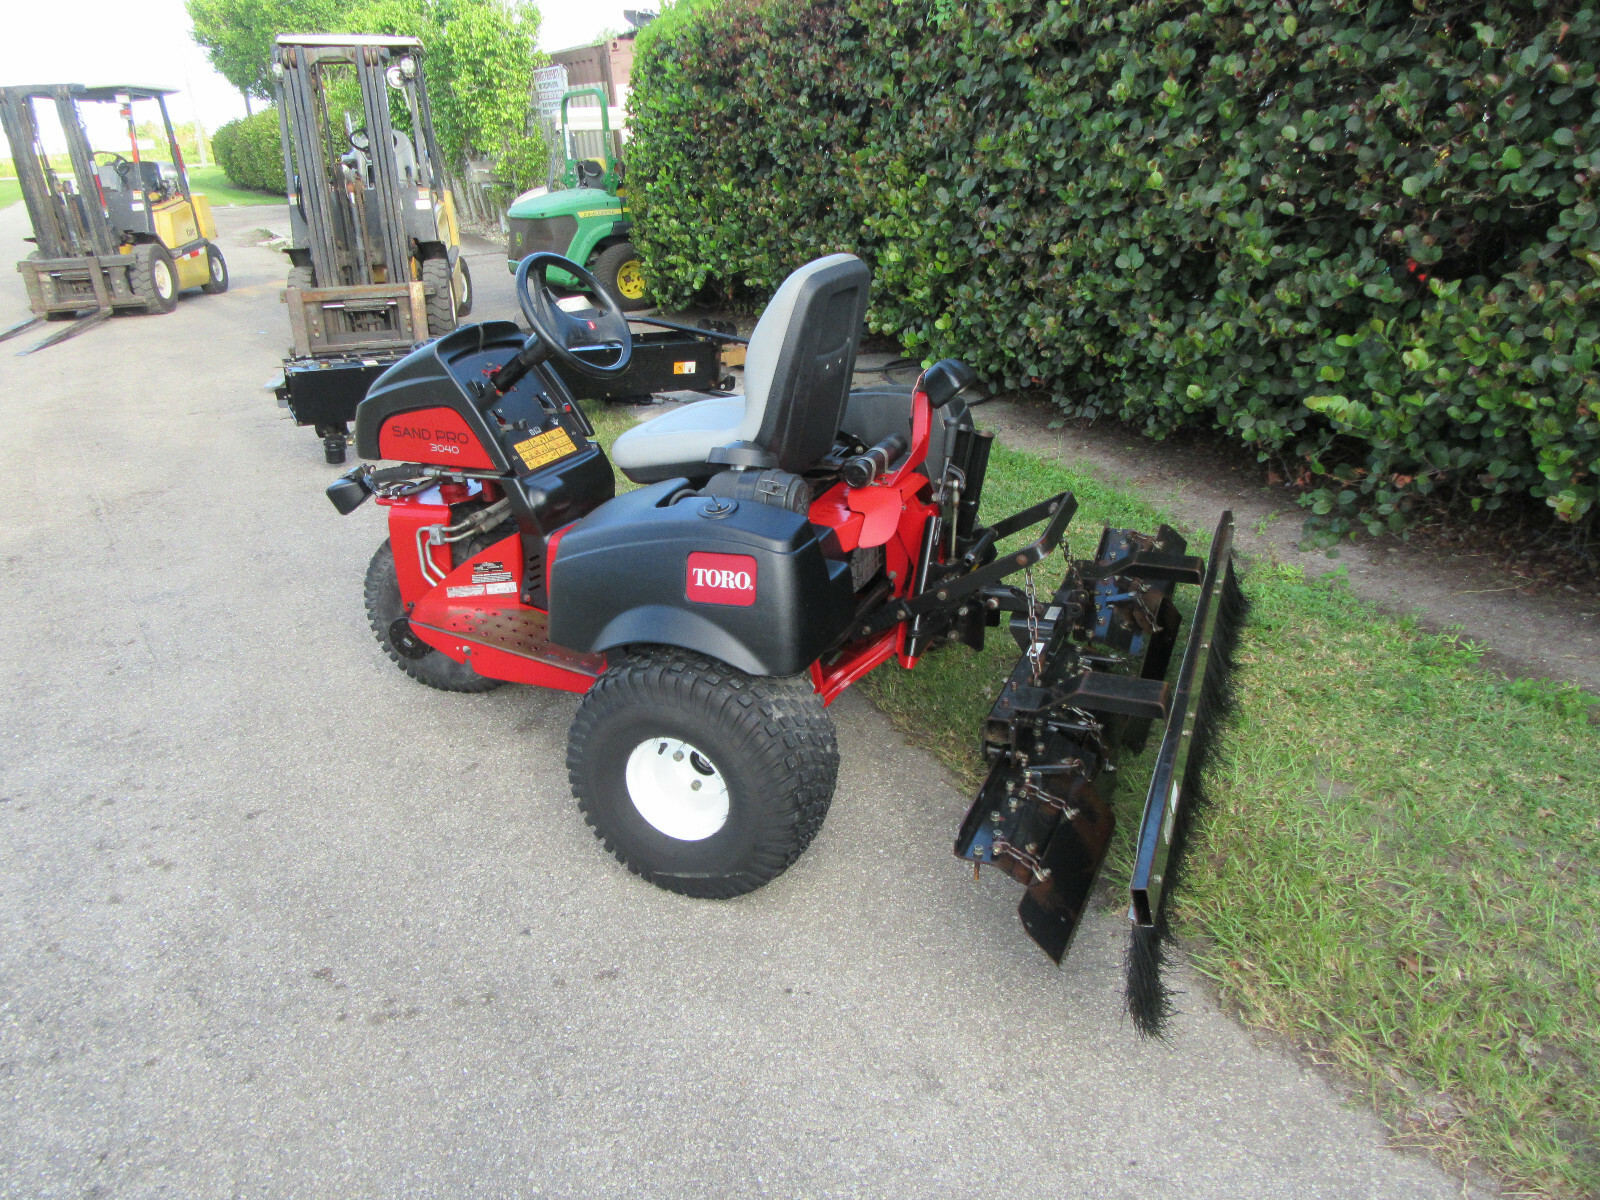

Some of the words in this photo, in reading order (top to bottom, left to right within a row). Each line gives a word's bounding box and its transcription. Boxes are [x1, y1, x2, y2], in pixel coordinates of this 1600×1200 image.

[392, 425, 431, 441] SAND
[435, 430, 469, 444] PRO
[429, 443, 460, 454] 3040
[692, 567, 751, 590] TORO
